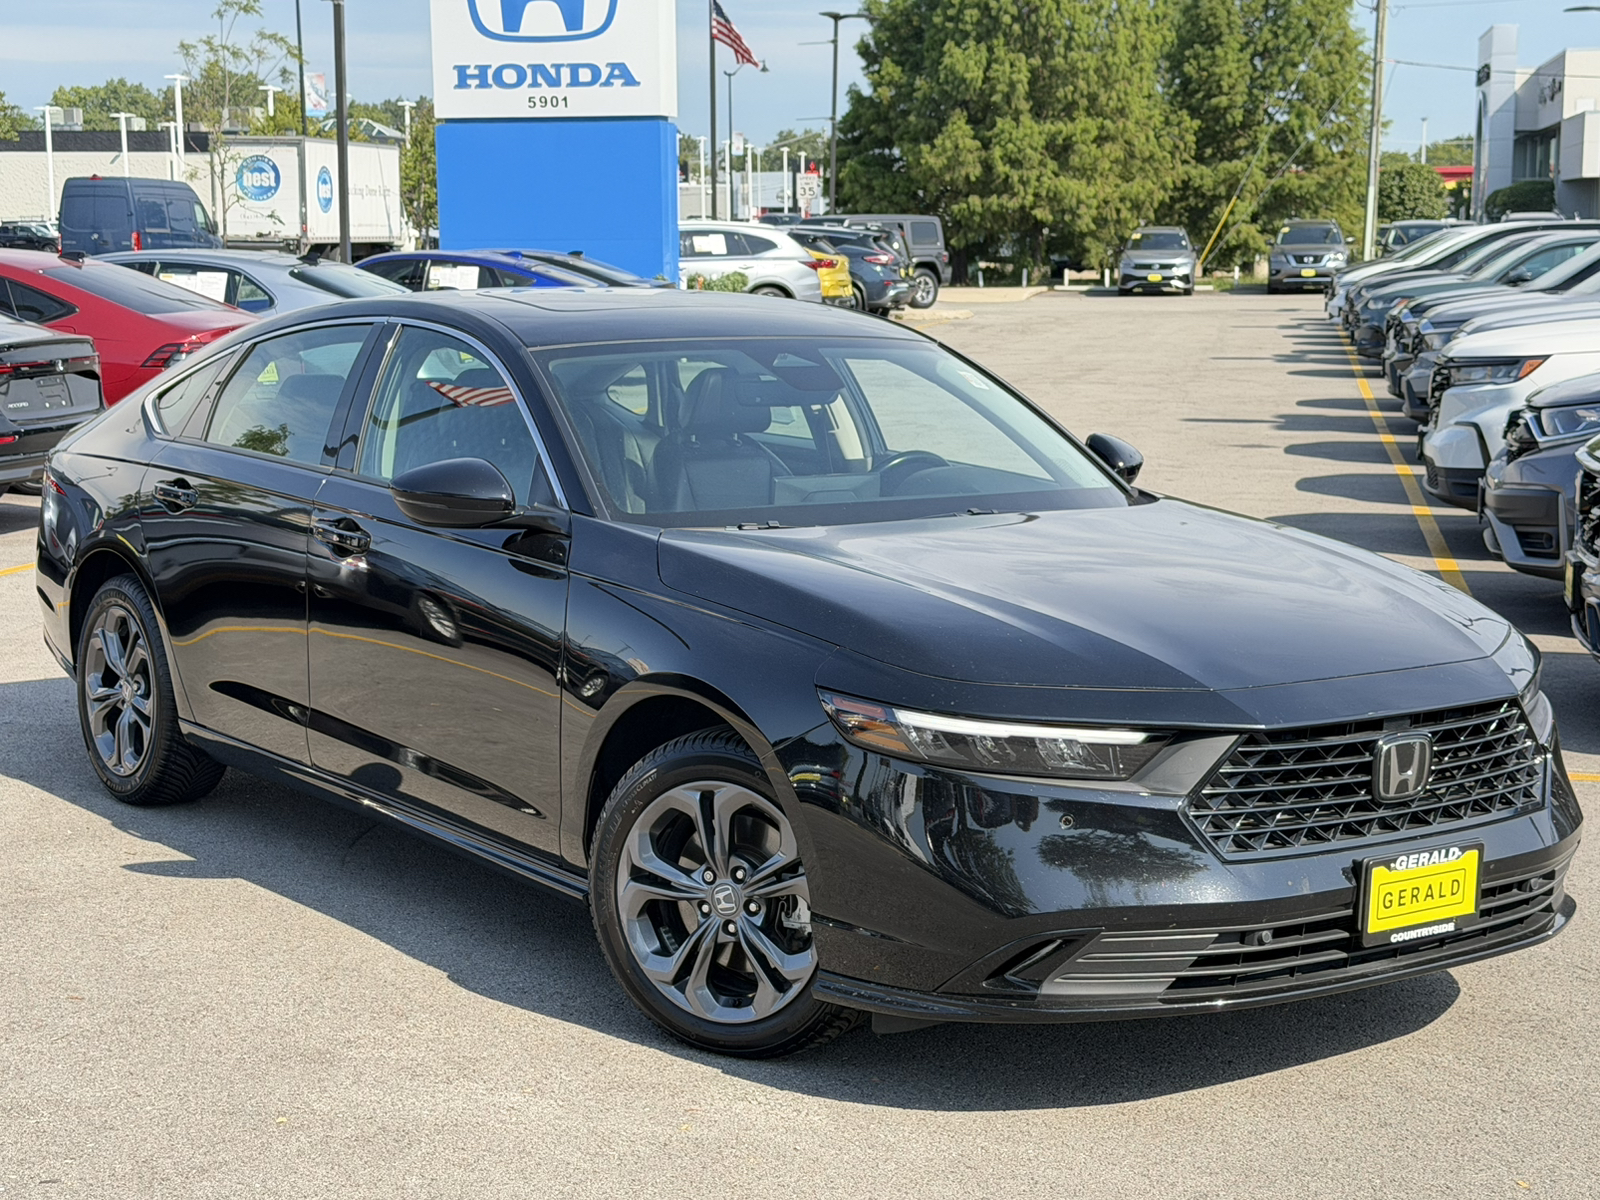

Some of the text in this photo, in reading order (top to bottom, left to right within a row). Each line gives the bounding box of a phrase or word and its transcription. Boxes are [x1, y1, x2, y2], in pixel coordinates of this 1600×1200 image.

[453, 62, 641, 90] HONDA
[528, 96, 569, 109] 5901
[800, 187, 816, 197] 35
[1395, 847, 1461, 871] GERALD
[1382, 879, 1461, 910] GERALD
[1390, 922, 1456, 943] COUNTRYSIDE
